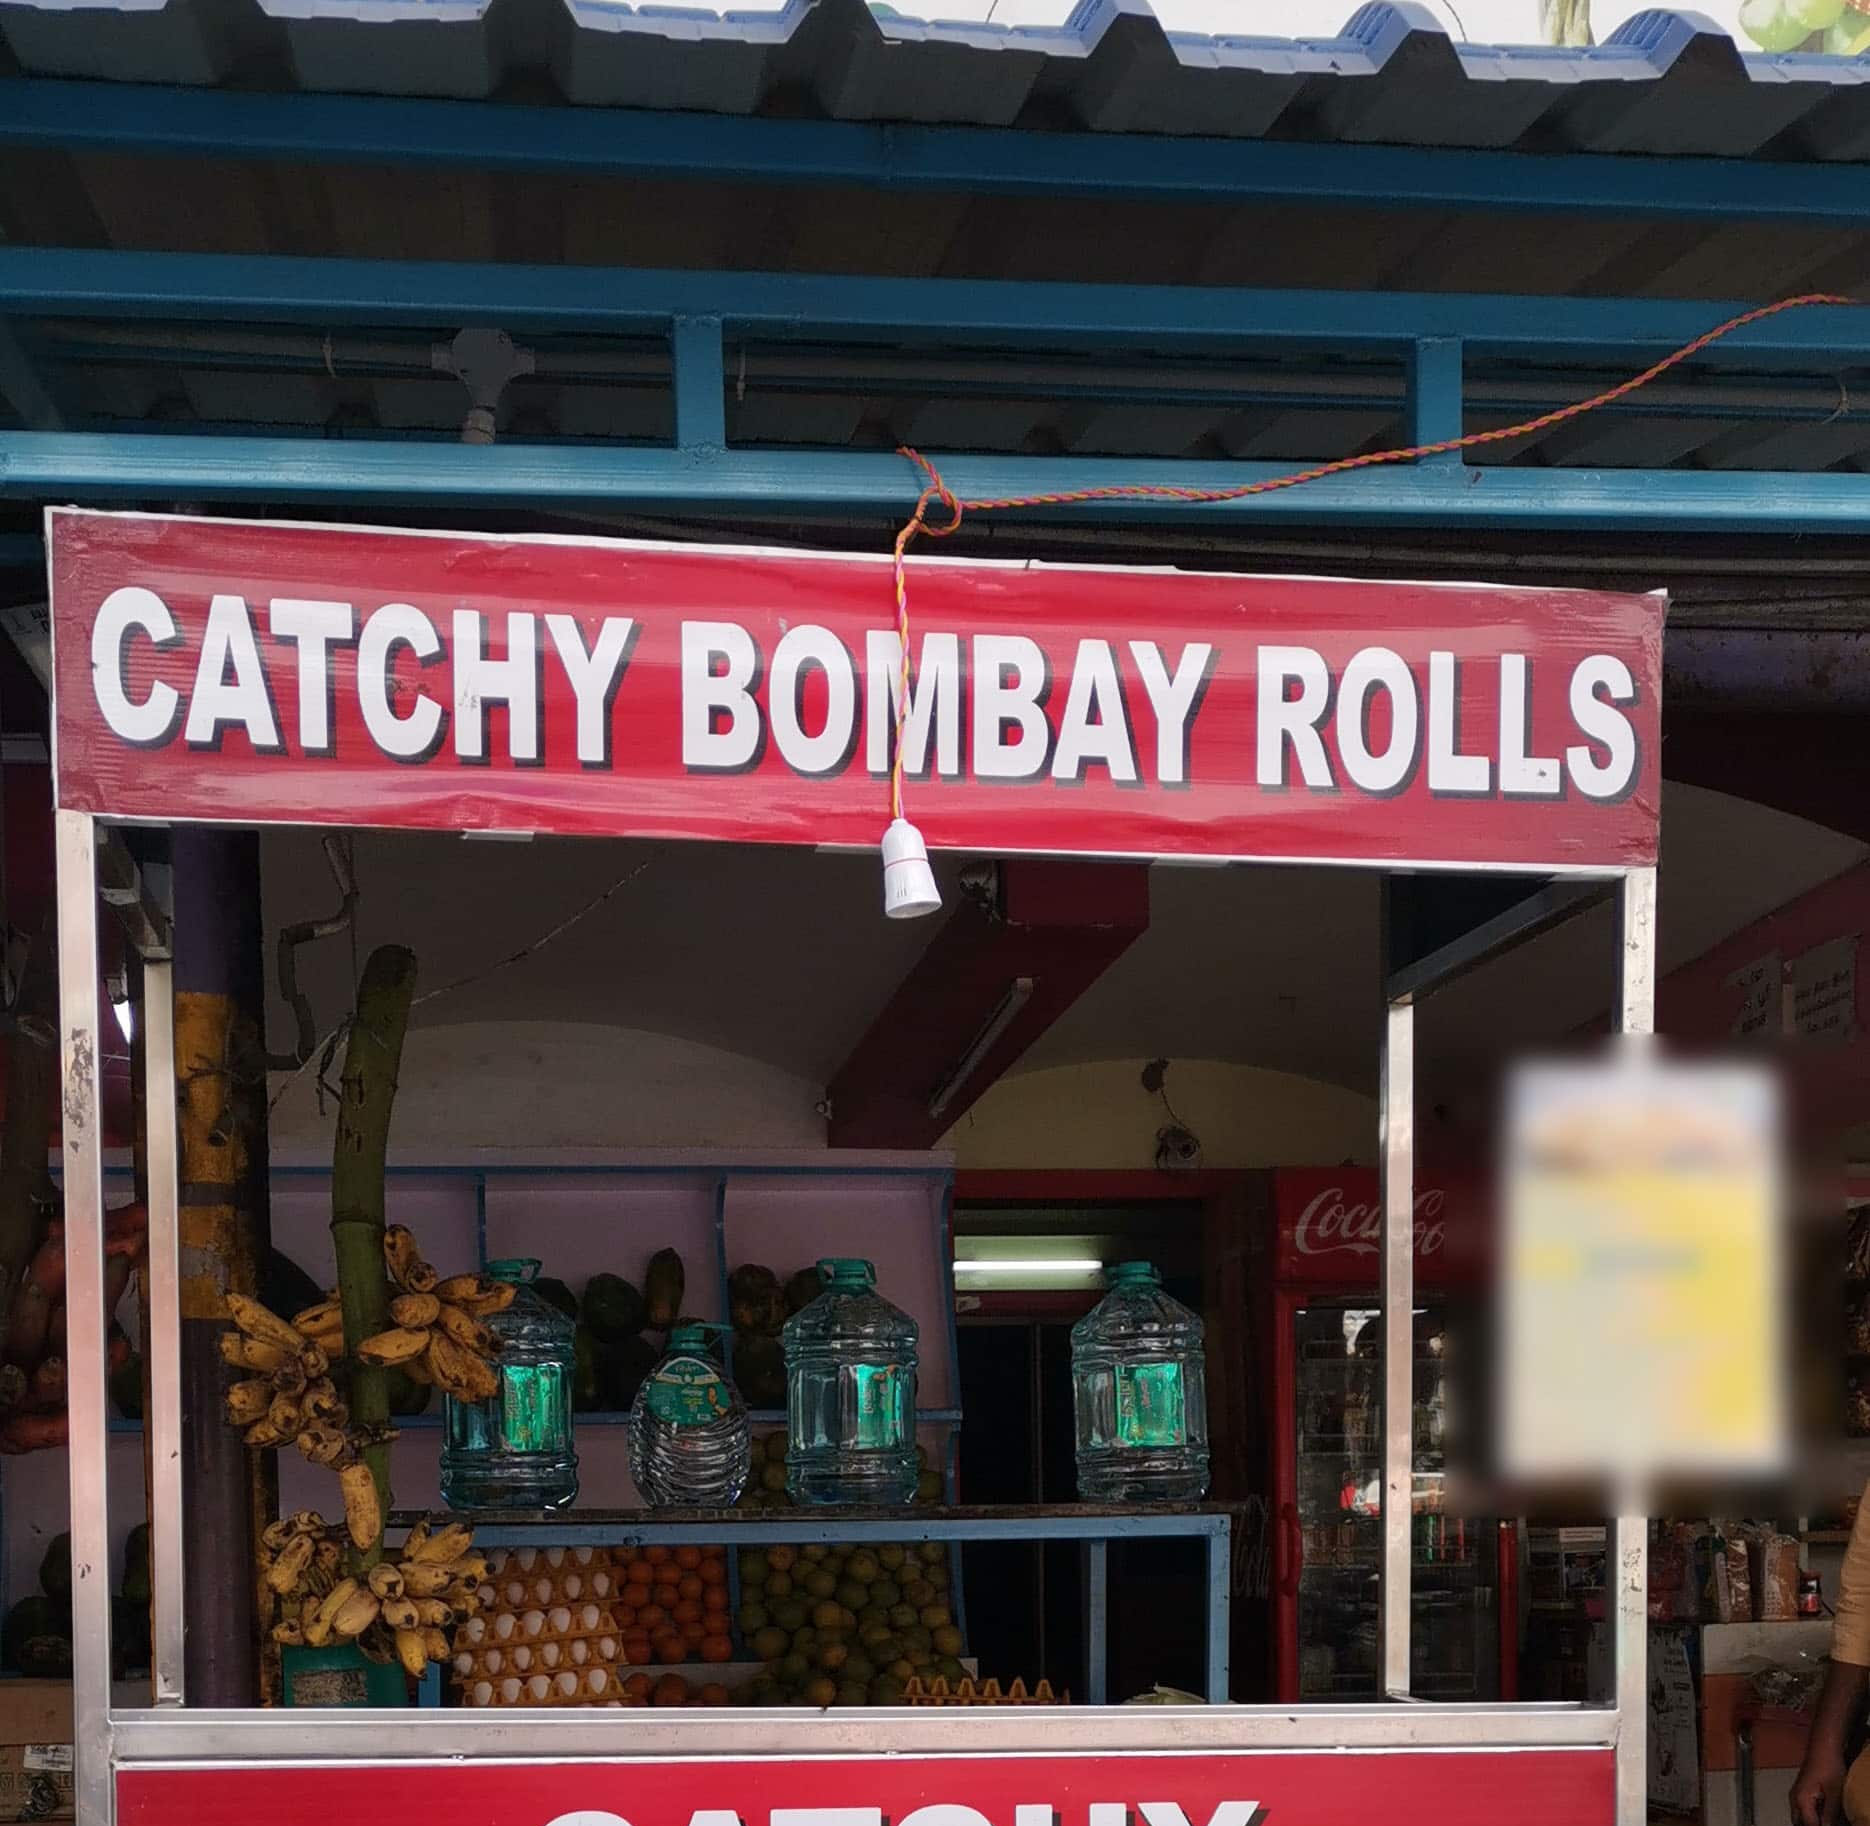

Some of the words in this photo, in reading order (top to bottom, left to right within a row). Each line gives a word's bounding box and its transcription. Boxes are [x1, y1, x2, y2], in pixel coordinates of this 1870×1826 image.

[91, 586, 636, 765] CATCHY
[680, 620, 1214, 784] BOMBAY
[1256, 645, 1638, 799] ROLLS
[1294, 1187, 1447, 1256] CocaCo
